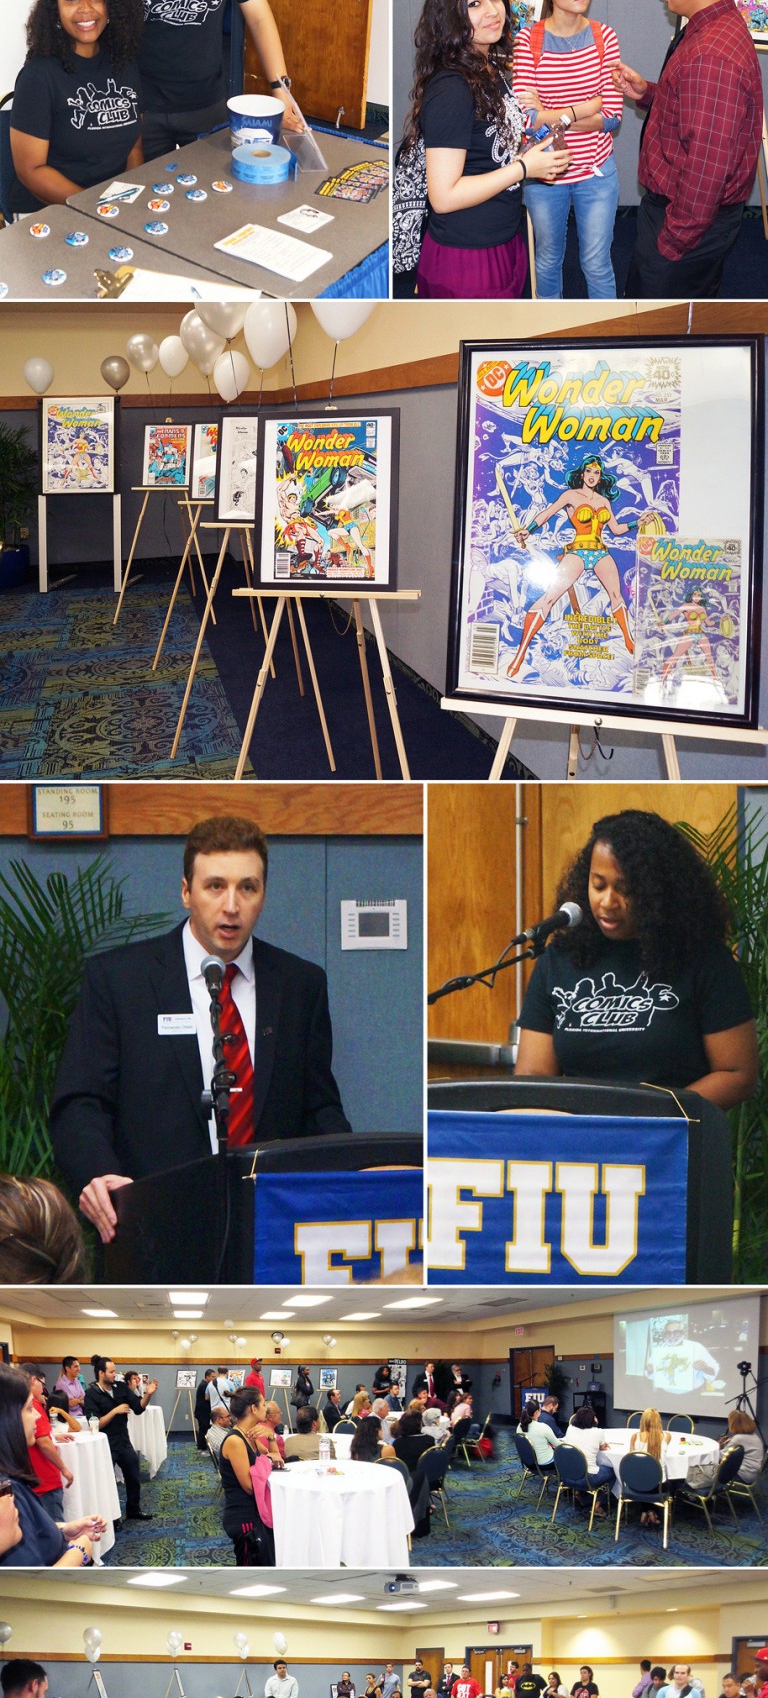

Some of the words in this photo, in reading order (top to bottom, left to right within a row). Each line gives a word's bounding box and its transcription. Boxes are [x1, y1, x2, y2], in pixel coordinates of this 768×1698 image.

[160, 11, 198, 22] CLUB
[87, 98, 131, 113] COMICS
[98, 109, 130, 125] CLUB
[485, 367, 504, 387] DC
[503, 365, 646, 407] Wonder
[62, 418, 102, 428] Woman
[278, 425, 288, 435] DC
[522, 404, 664, 443] Woman
[286, 430, 355, 453] Wonder
[295, 450, 365, 470] Woman
[651, 540, 724, 562] Wonder
[661, 561, 733, 582] Woman
[59, 795, 76, 804] 195
[62, 820, 74, 830] 95
[572, 995, 653, 1012] COMICS
[581, 1011, 638, 1026] CLUB
[427, 1157, 646, 1276] FIU
[524, 1392, 545, 1403] FIU
